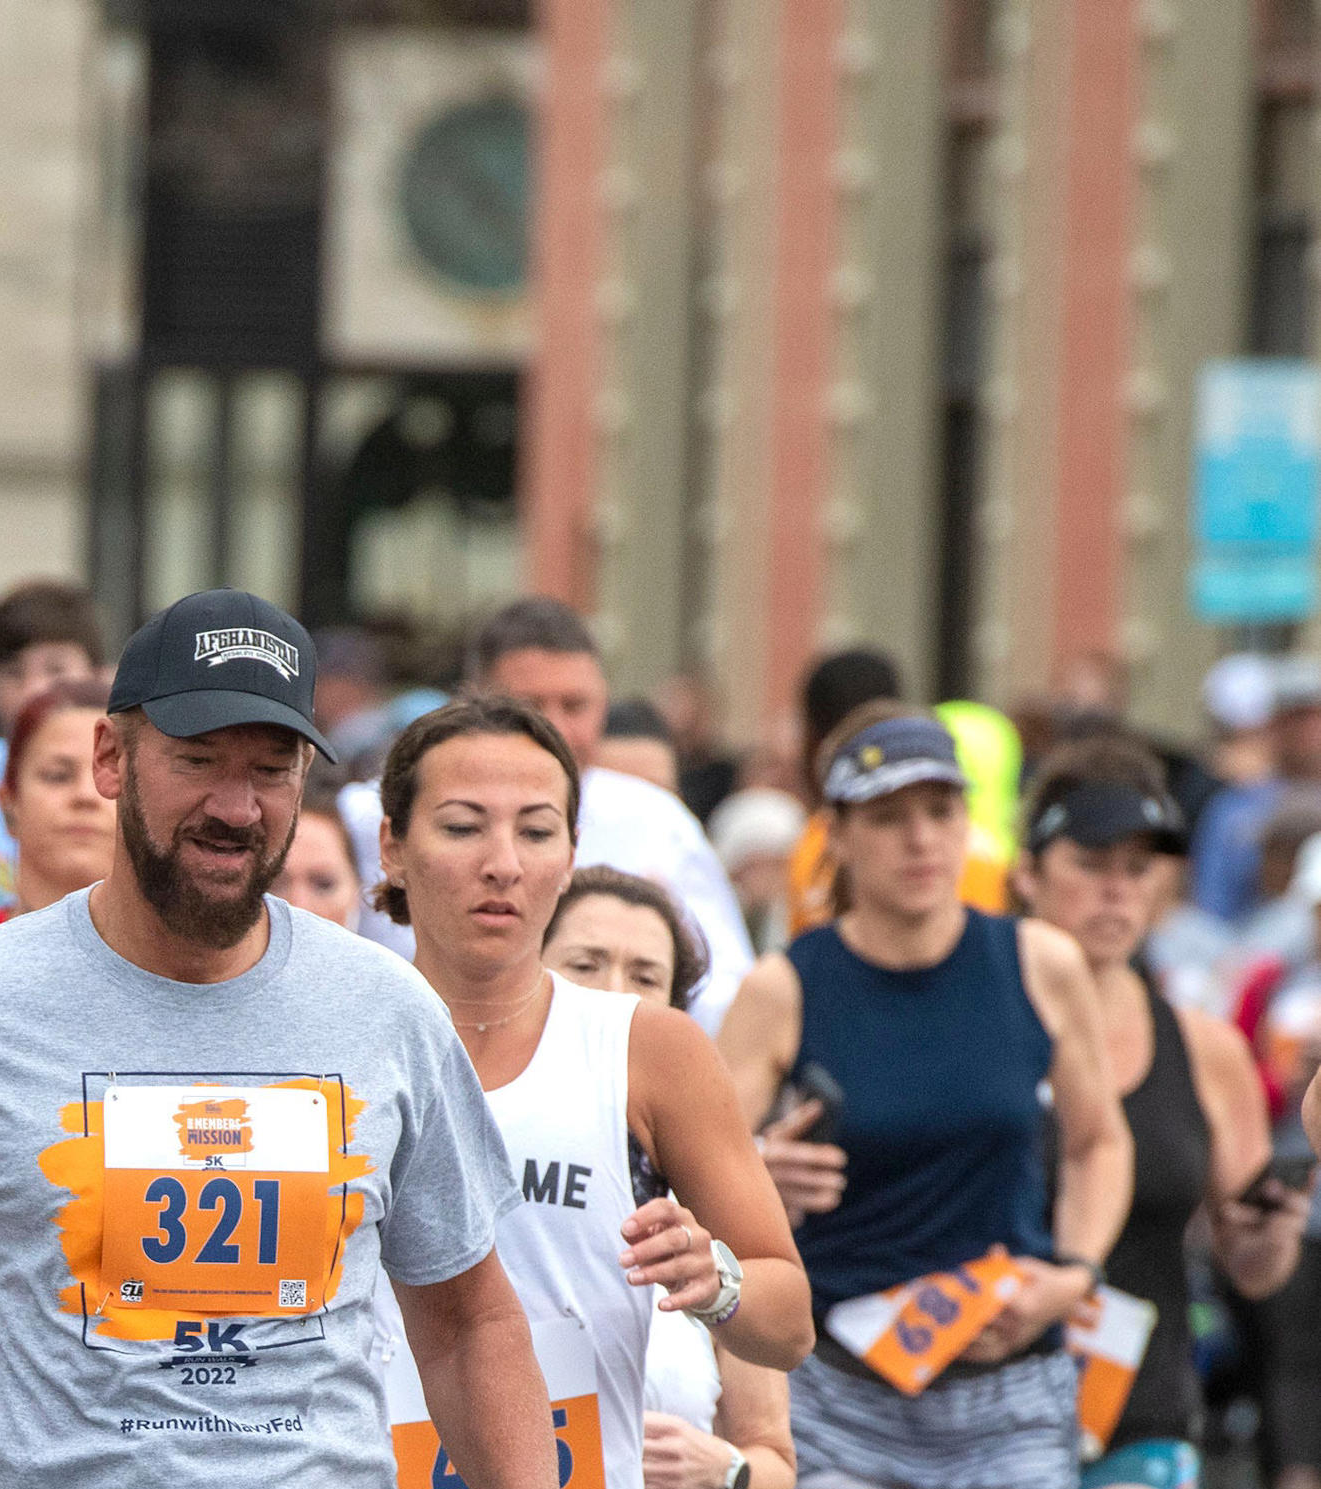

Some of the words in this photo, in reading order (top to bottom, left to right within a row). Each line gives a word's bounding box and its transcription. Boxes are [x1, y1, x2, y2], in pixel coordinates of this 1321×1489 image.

[197, 629, 298, 674] AFGHANISTAN
[187, 1129, 242, 1145] MISSION
[204, 1155, 224, 1167] 5K
[522, 1158, 593, 1210] ME
[140, 1176, 280, 1265] 321
[174, 1320, 251, 1352] 5K
[180, 1366, 237, 1386] 2022
[120, 1415, 304, 1435] #RunwithNavyFed
